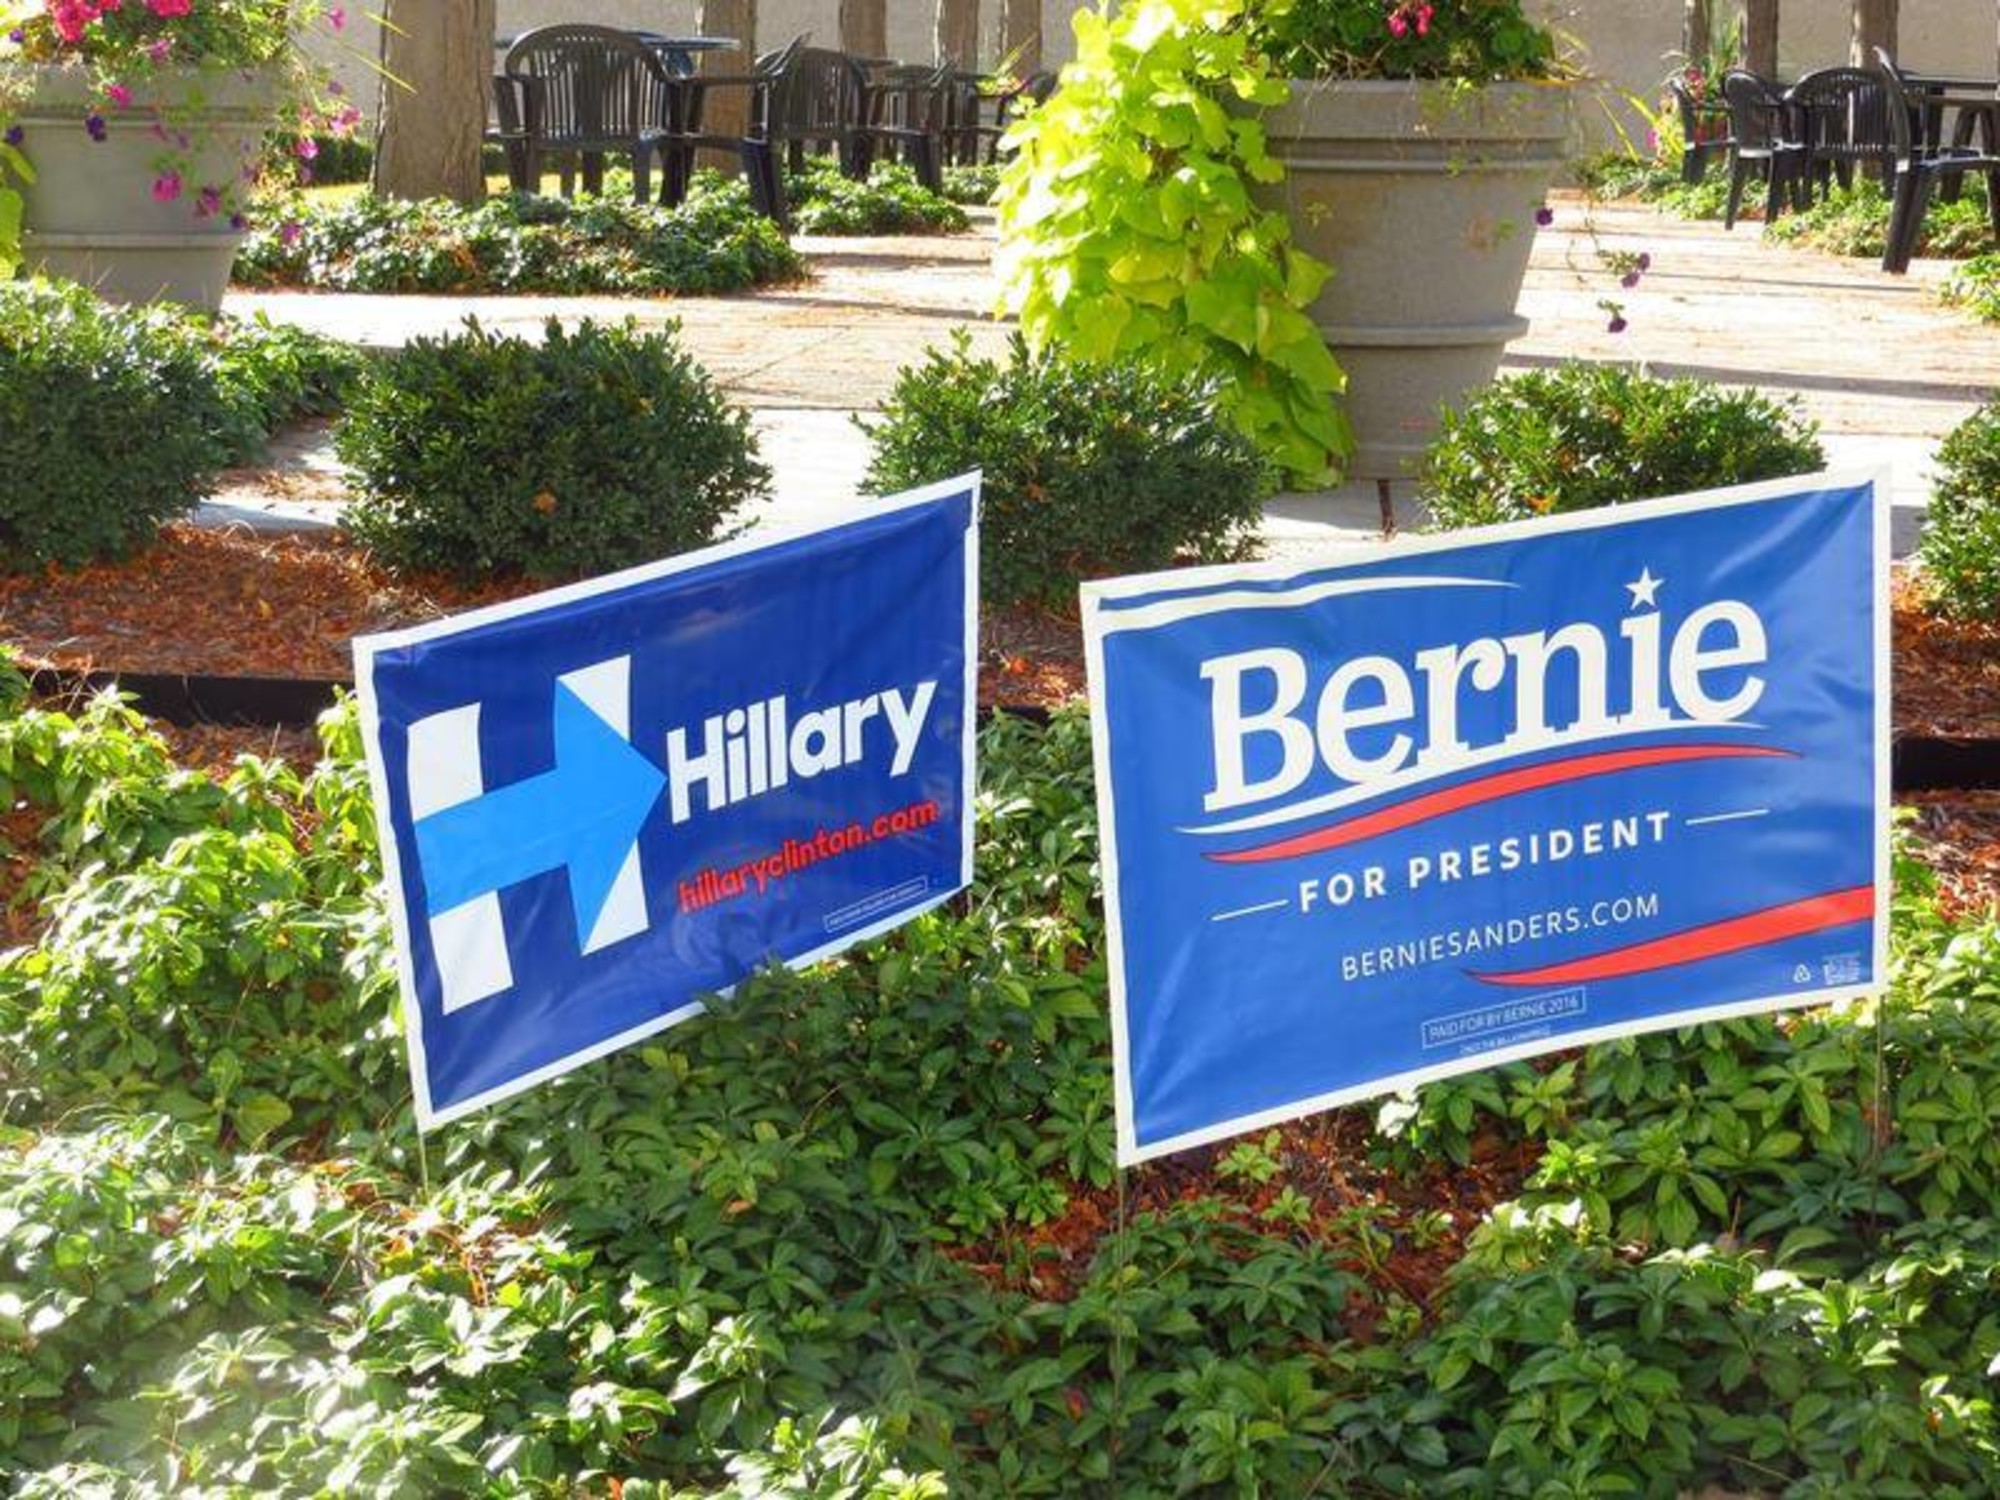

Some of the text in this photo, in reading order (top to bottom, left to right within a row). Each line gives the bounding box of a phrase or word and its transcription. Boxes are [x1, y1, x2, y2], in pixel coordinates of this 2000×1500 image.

[1199, 568, 1768, 812] Bernie
[666, 681, 938, 823] Hillary
[678, 801, 939, 912] hillaryclinton.com
[1300, 812, 1670, 913] FOR PRESIDENT
[1342, 894, 1659, 981] BERNIESANDERS.COM
[1429, 1019, 1457, 1041] PAID
[1459, 1013, 1485, 1034] FOR
[1487, 1008, 1502, 1026] BY
[1504, 1000, 1546, 1023] BERNIE
